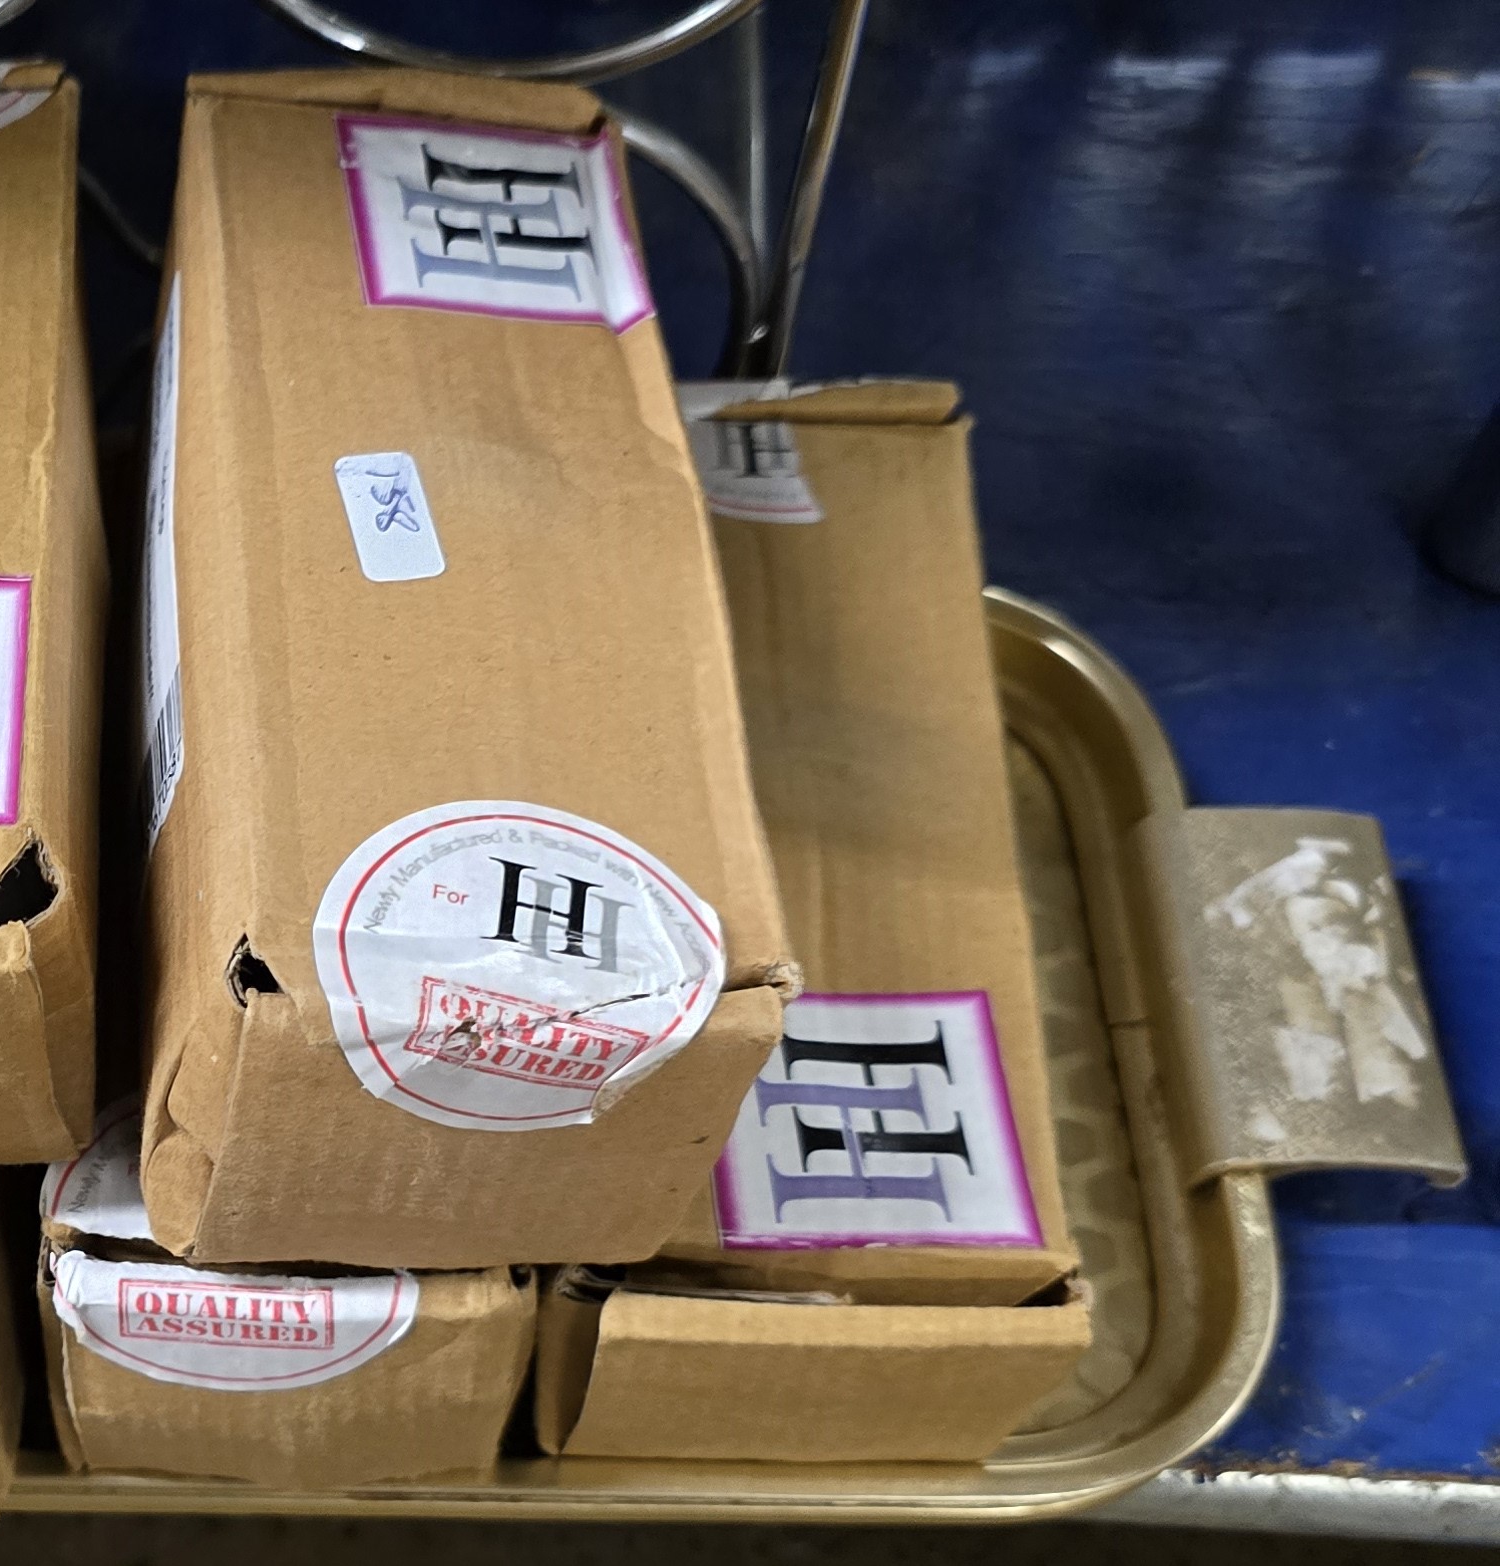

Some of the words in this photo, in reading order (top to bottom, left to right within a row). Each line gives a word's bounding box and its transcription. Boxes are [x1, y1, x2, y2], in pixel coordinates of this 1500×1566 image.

[363, 883, 402, 934] Newly
[390, 829, 503, 887] Manufactured
[508, 829, 524, 844] &
[529, 831, 601, 863] Packed
[605, 859, 639, 887] with
[432, 883, 470, 906] For
[134, 1290, 319, 1326] QUALITY
[135, 1317, 319, 1343] ASSURED
